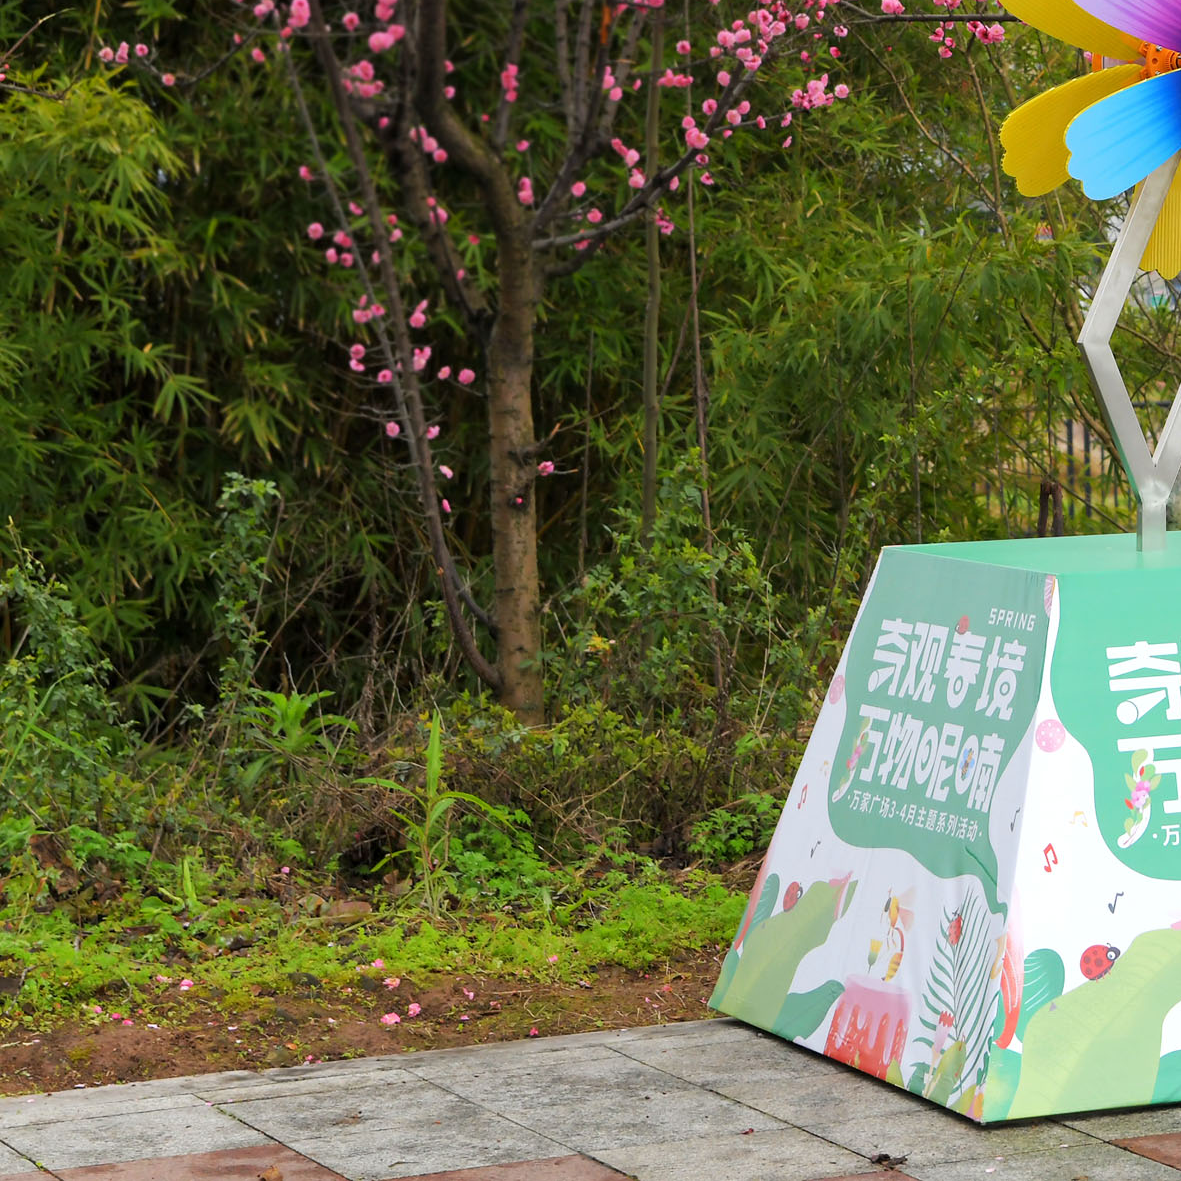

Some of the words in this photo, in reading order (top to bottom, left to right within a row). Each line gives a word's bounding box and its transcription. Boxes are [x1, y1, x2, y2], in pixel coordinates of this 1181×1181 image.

[868, 618, 1027, 721] 奇观春境
[988, 608, 1036, 631] SPRING
[832, 704, 1005, 813] 万物呢喃
